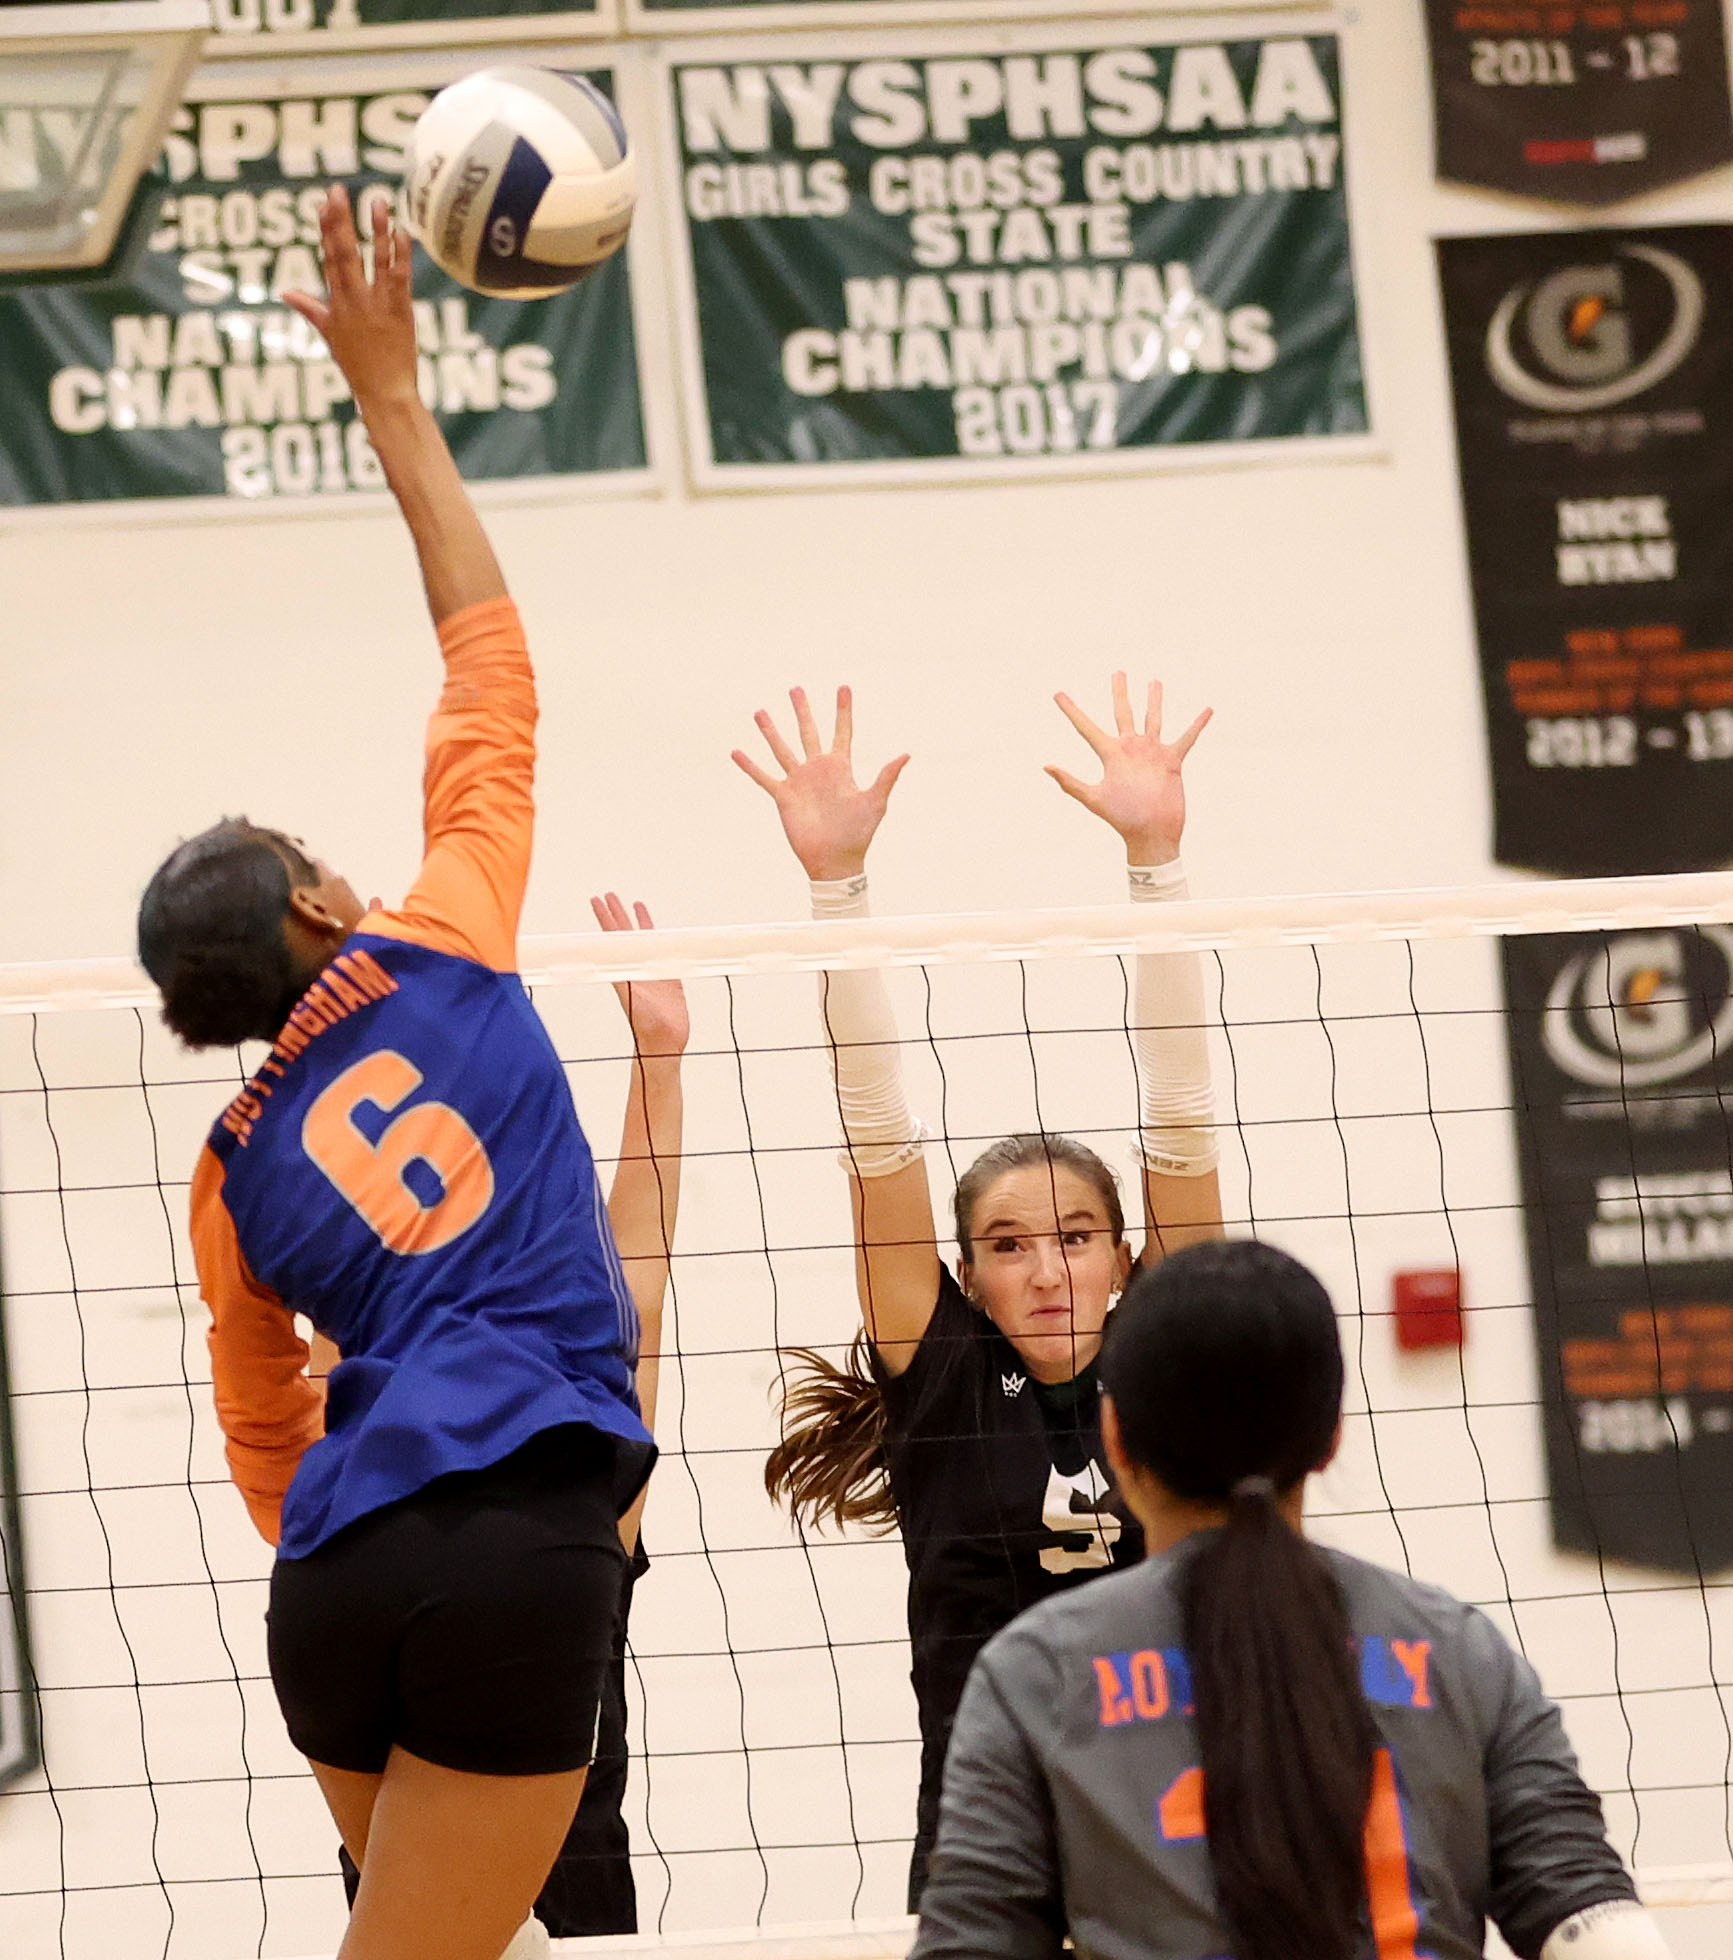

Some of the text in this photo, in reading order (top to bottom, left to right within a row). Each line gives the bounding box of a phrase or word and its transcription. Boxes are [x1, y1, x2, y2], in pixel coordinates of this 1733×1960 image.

[678, 38, 1338, 153] NYSPHSAA
[1470, 38, 1577, 86] 2011
[1623, 31, 1681, 80] 12
[684, 133, 1340, 221] GIRLS CROSS COUNTRY
[909, 203, 1134, 268] STATE
[111, 300, 486, 369] NATIOL
[844, 261, 1197, 333] NATIONAL
[49, 344, 557, 434] CHAMPNS
[782, 304, 1279, 397] CHAMPIONS
[220, 420, 388, 499] 2016
[951, 382, 1120, 458] 2017
[302, 1049, 495, 1256] 6
